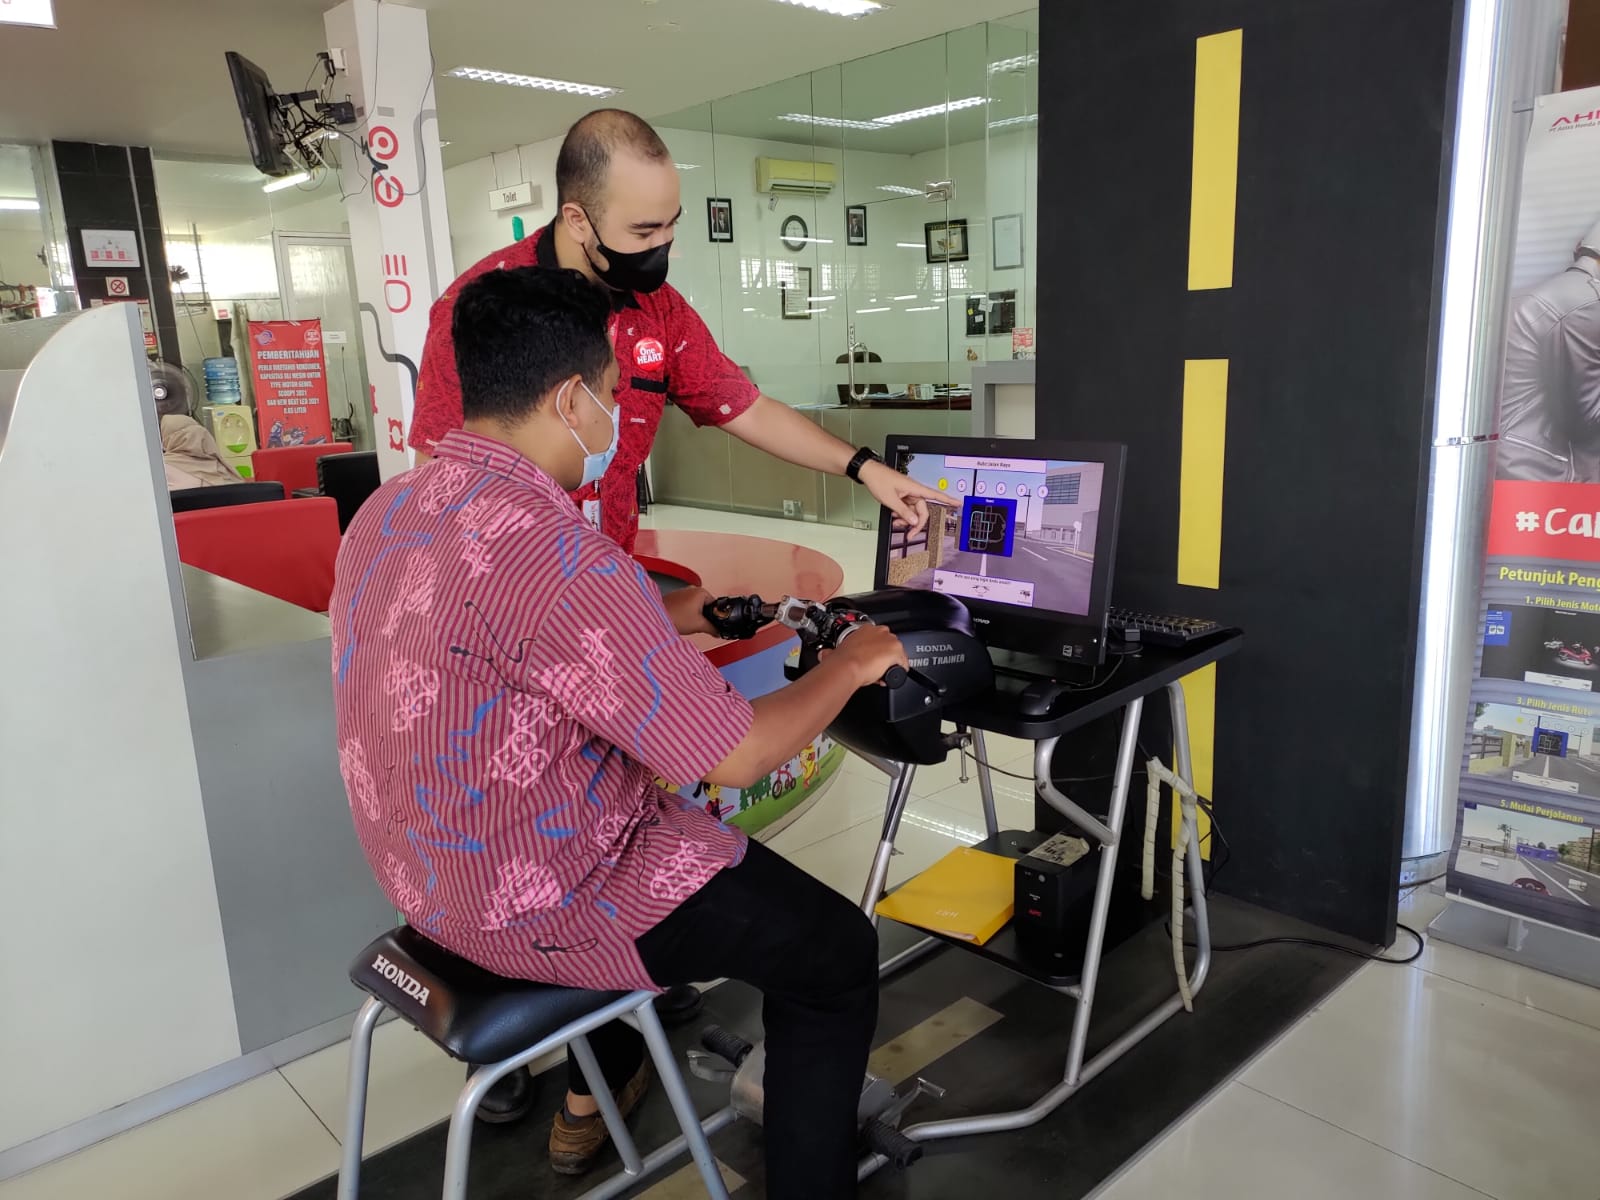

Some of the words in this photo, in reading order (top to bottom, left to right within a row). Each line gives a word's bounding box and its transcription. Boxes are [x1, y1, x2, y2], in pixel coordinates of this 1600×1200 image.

[502, 191, 517, 203] Toilet
[257, 350, 319, 360] PEMBERITAHUAN
[640, 347, 655, 355] One
[1500, 567, 1565, 586] Petunjuk
[1525, 596, 1534, 604] 1.
[1535, 596, 1555, 606] Pilih
[1556, 599, 1579, 609] Jenis
[915, 643, 954, 653] HONDA
[908, 657, 930, 667] DING
[932, 653, 966, 666] TRAINER
[1526, 696, 1546, 709] Pilih
[1500, 799, 1509, 808] 5.
[1510, 801, 1534, 814] Mulai
[1535, 806, 1584, 824] Perjalanan
[371, 953, 431, 1007] HONDA
